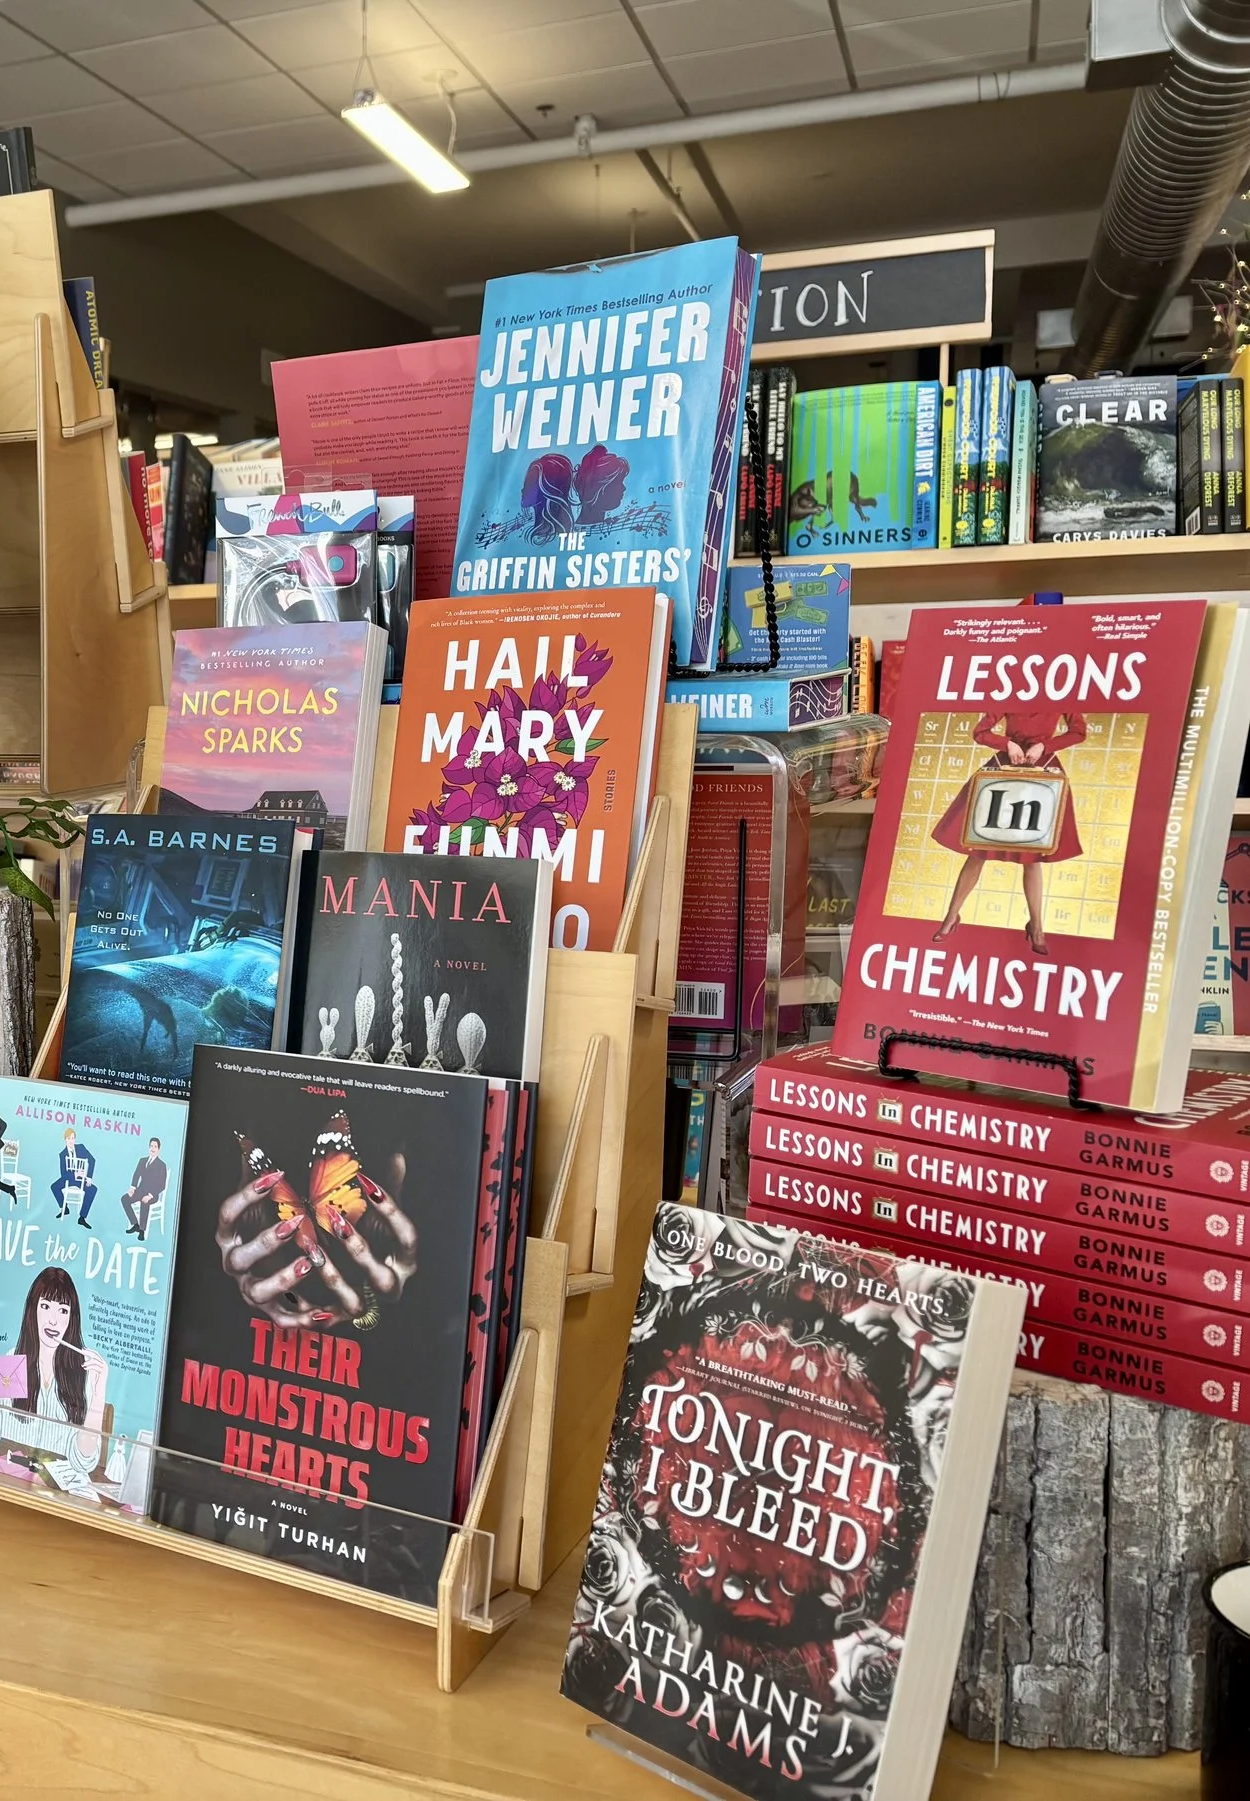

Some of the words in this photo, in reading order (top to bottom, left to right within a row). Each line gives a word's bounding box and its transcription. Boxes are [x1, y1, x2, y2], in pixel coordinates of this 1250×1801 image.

[85, 290, 99, 346] ATOMIC
[510, 312, 535, 327] New
[539, 306, 562, 320] York
[565, 302, 598, 316] Times
[601, 291, 664, 312] Bestselling
[668, 282, 713, 301] Author
[480, 301, 712, 388] JENNIFER
[491, 372, 683, 454] WEINER
[916, 387, 936, 448] AMERICAN
[1056, 399, 1168, 425] CLEAR
[915, 449, 935, 477] DIRT
[247, 502, 309, 530] French
[1053, 530, 1101, 543] CARYS
[1109, 528, 1167, 541] DAVIES
[558, 531, 586, 552] THE
[822, 528, 912, 547] SINNERS
[456, 554, 556, 592] GRIFFIN
[224, 649, 248, 657] NEW
[251, 648, 277, 656] YORK
[281, 646, 314, 655] TIMES
[944, 628, 967, 636] Darkly
[200, 660, 271, 670] BESTSELLING
[278, 658, 325, 668] AUTHOR
[443, 634, 589, 691] HAIL
[936, 651, 1147, 702] LESSONS
[181, 687, 339, 717] NICHOLAS
[1190, 686, 1210, 718] THE
[202, 726, 303, 754] SPARKS
[420, 709, 605, 764] MARY
[603, 769, 617, 812] STORIES
[709, 783, 763, 793] FRIENDS
[982, 788, 1044, 832] In
[91, 829, 135, 846] S.A.
[148, 830, 278, 853] BARNES
[319, 875, 512, 924] MANIA
[446, 960, 487, 972] NOVEL
[1143, 909, 1170, 1013] BESTSELLER
[860, 943, 1123, 1022] CHEMISTRY
[223, 1063, 242, 1073] darkly
[281, 1070, 311, 1081] evocative
[327, 1089, 347, 1098] LIPA
[15, 1104, 76, 1126] ALLISON
[83, 1114, 142, 1137] RASKIN
[770, 1079, 868, 1118] LESSONS
[910, 1104, 1051, 1153] CHEMISTRY
[1079, 1150, 1174, 1179] GARMUS
[1084, 1130, 1172, 1159] BONNIE
[765, 1126, 863, 1167] LESSONS
[906, 1154, 1048, 1204] CHEMISTRY
[765, 1173, 863, 1215] LESSONS
[906, 1204, 1047, 1256] CHEMISTRY
[1075, 1202, 1170, 1232] GARMUS
[1080, 1183, 1167, 1212] BONNIE
[1235, 1214, 1246, 1246] VINTAGE
[44, 1234, 79, 1264] the
[84, 1236, 166, 1296] DATE
[667, 1229, 706, 1253] ONE
[713, 1243, 788, 1277] BLOOD.
[798, 1262, 849, 1290] TWO
[856, 1279, 949, 1318] HEARTS.
[250, 1316, 362, 1389] THEIR
[707, 1358, 786, 1393] BREATHTAKING
[181, 1358, 430, 1466] MONSTROUS
[220, 1425, 370, 1511] HEARTS
[211, 1502, 269, 1534] YIĞIT
[278, 1521, 368, 1564] TURHAN
[670, 1458, 868, 1573] BLEED
[592, 1601, 823, 1739] KATHARINE
[832, 1716, 854, 1759] J.
[615, 1657, 807, 1781] ADAMS
